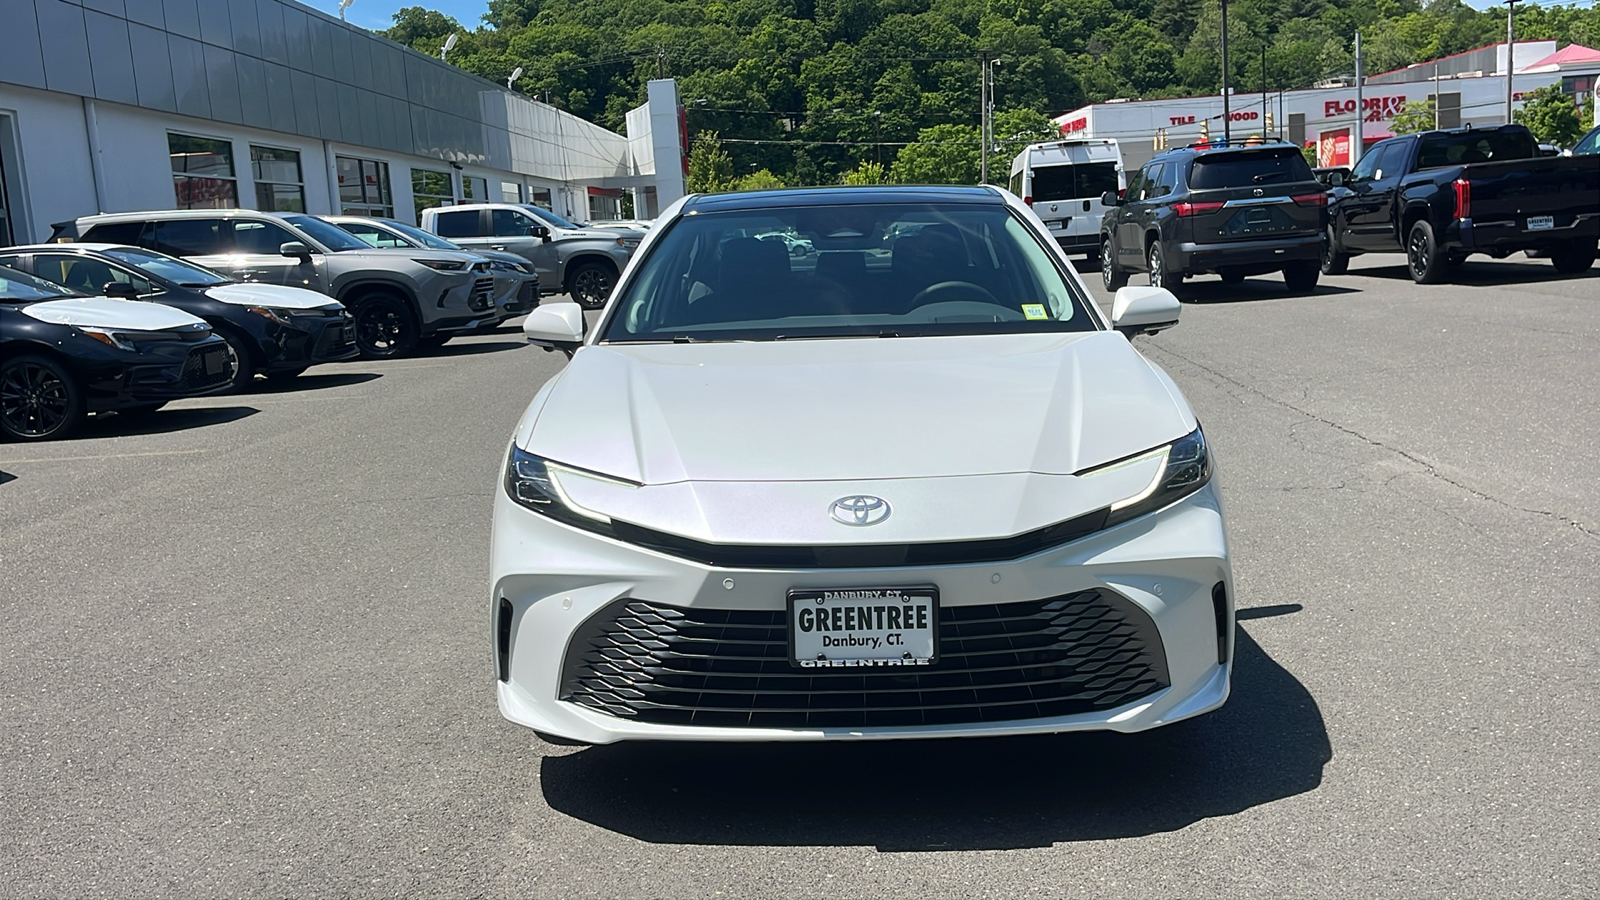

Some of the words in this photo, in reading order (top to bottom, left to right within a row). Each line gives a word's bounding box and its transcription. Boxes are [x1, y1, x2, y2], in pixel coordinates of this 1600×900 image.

[1325, 97, 1381, 113] FLOOR
[1170, 116, 1195, 125] TILE
[1222, 111, 1258, 122] WOOD
[798, 605, 928, 632] GREENTREE
[823, 633, 882, 649] Danbury,
[886, 633, 904, 646] CT.
[800, 658, 930, 668] GREENTREE
